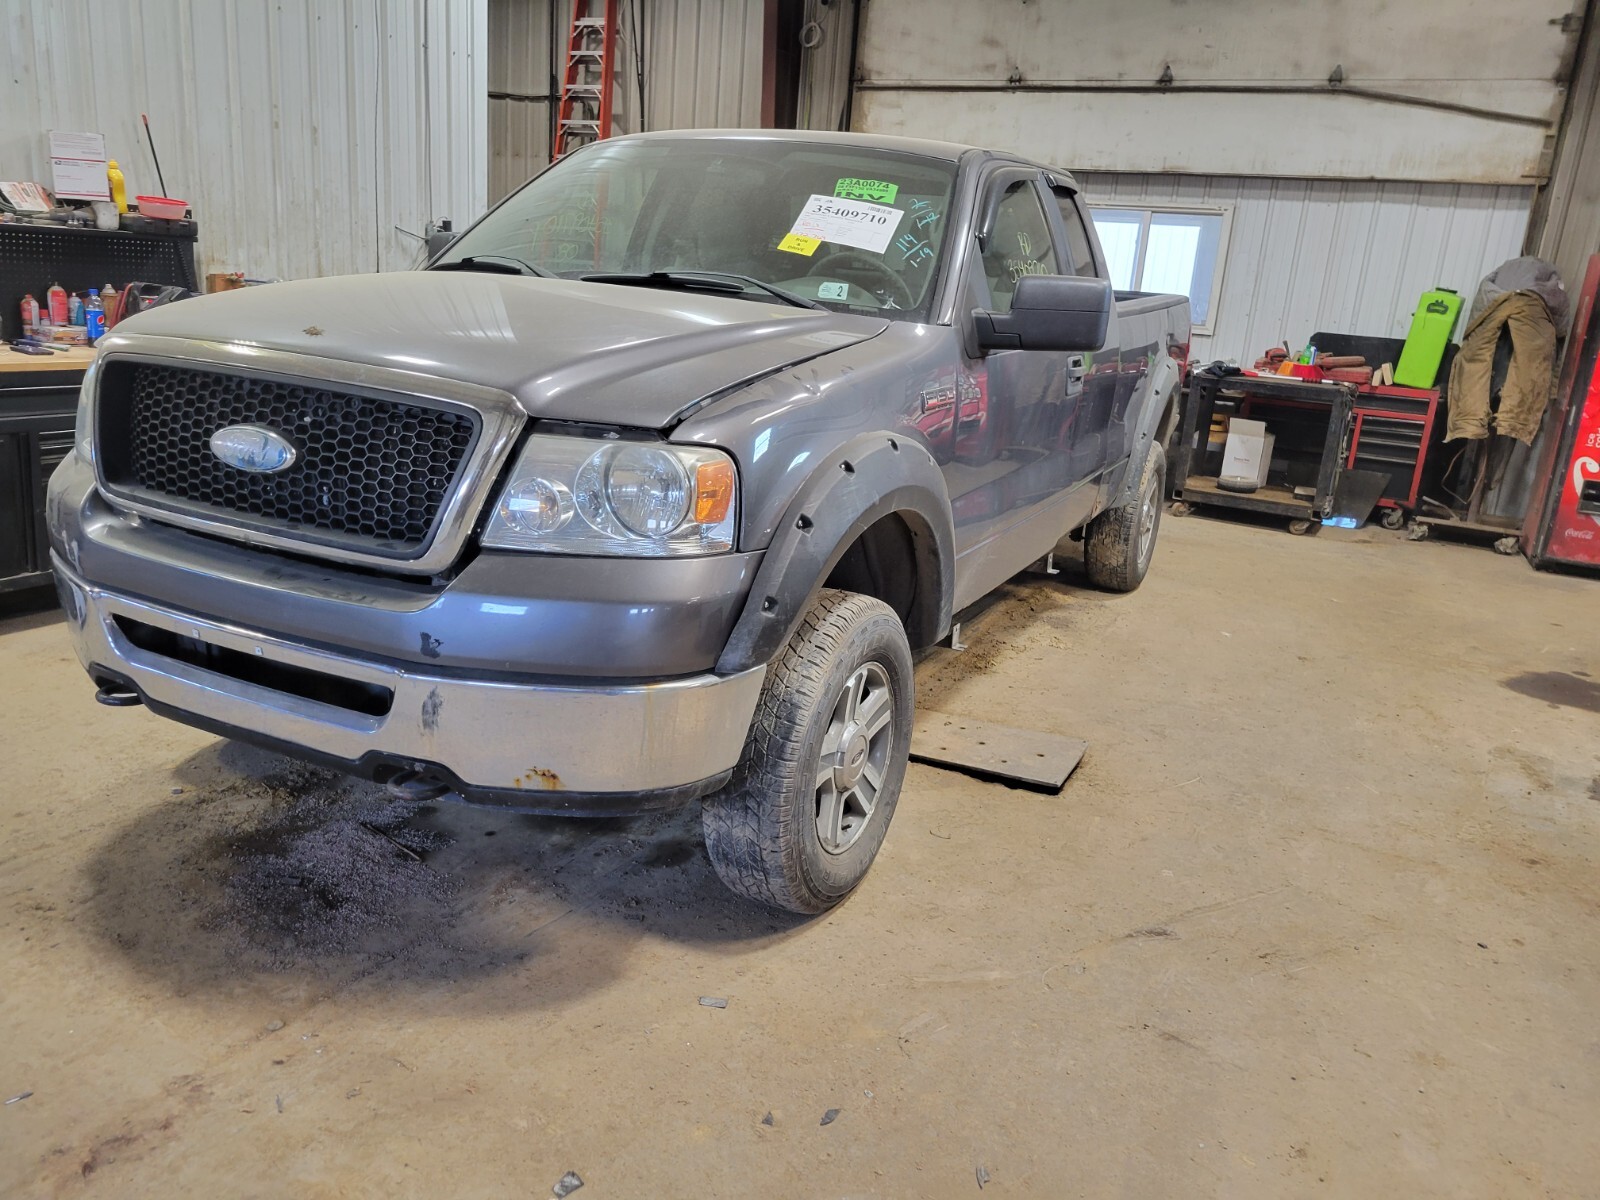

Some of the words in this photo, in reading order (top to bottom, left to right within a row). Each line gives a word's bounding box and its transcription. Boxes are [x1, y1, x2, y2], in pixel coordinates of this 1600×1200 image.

[839, 178, 890, 189] 23A0074
[812, 204, 887, 225] 35409710
[836, 285, 843, 297] 2
